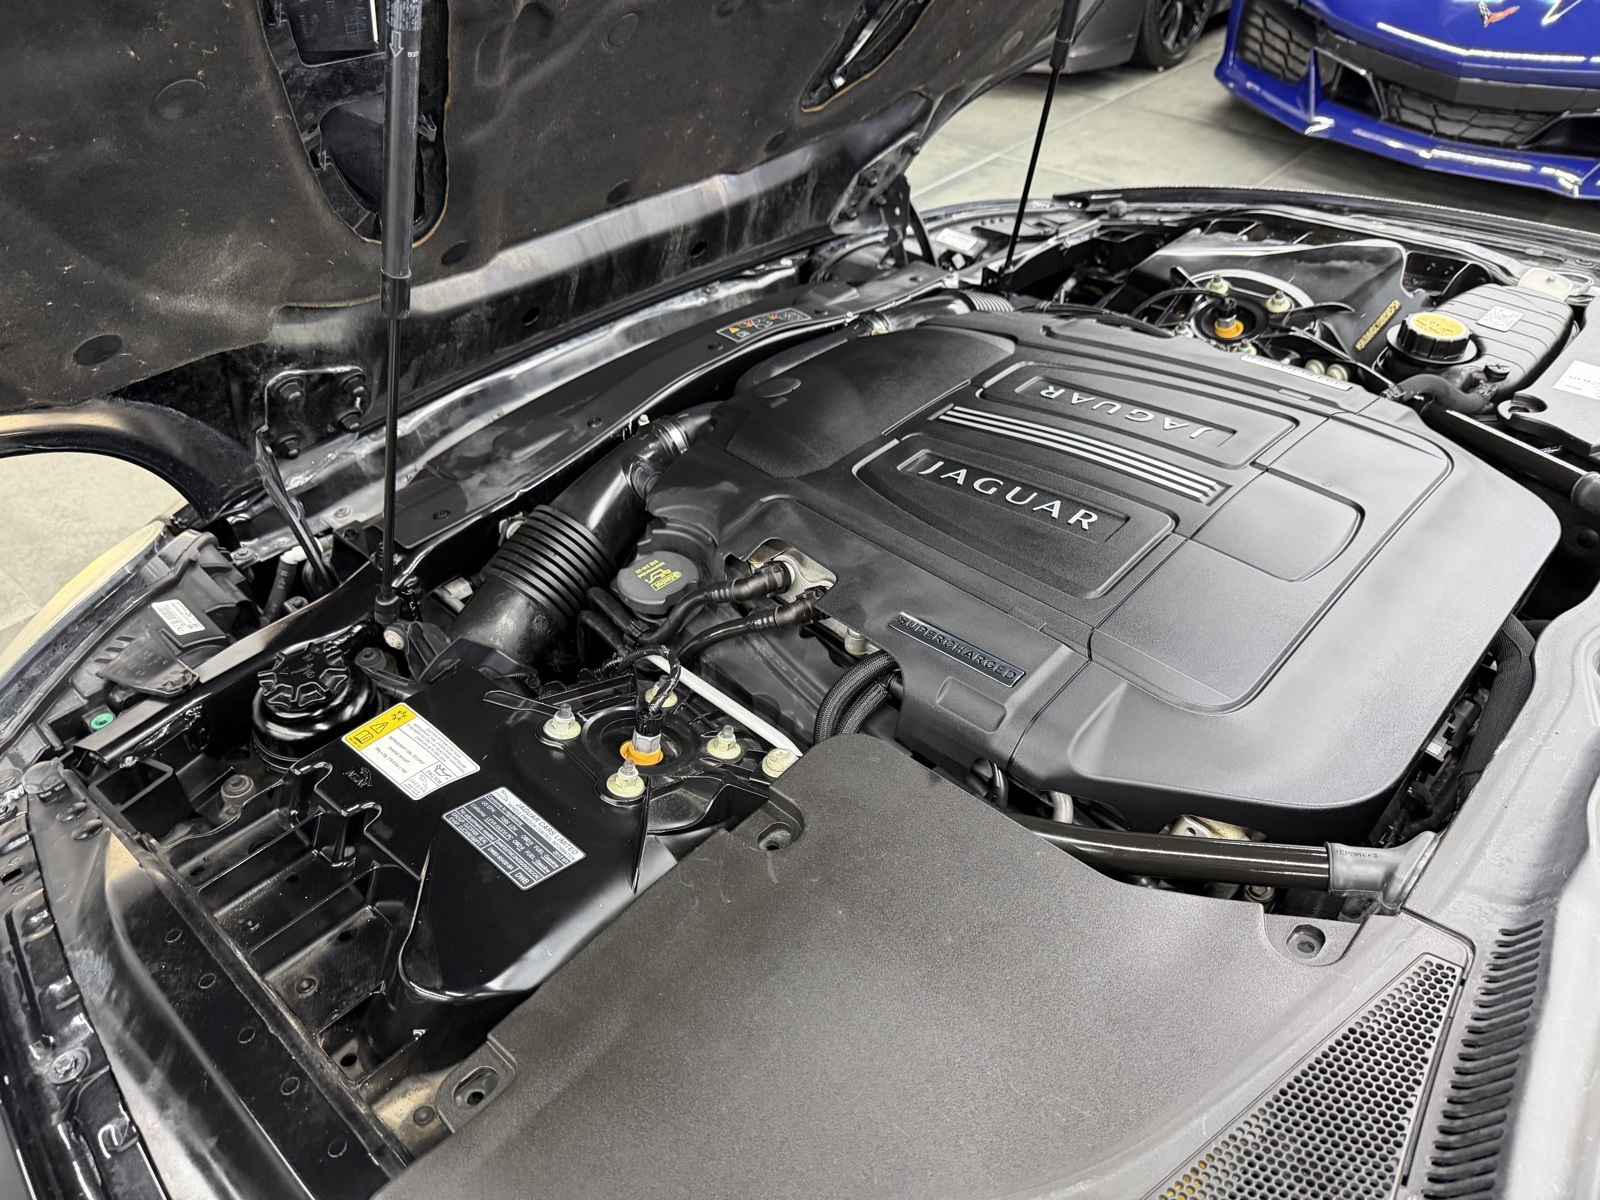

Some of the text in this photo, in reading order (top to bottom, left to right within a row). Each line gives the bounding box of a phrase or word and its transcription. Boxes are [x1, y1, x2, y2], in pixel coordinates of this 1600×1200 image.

[1039, 385, 1214, 439] JAGUAR
[918, 461, 1099, 531] JAGUAR
[897, 616, 1017, 680] SUPERCHARGED
[514, 802, 579, 855] JAGUAR CARS LIMITED
